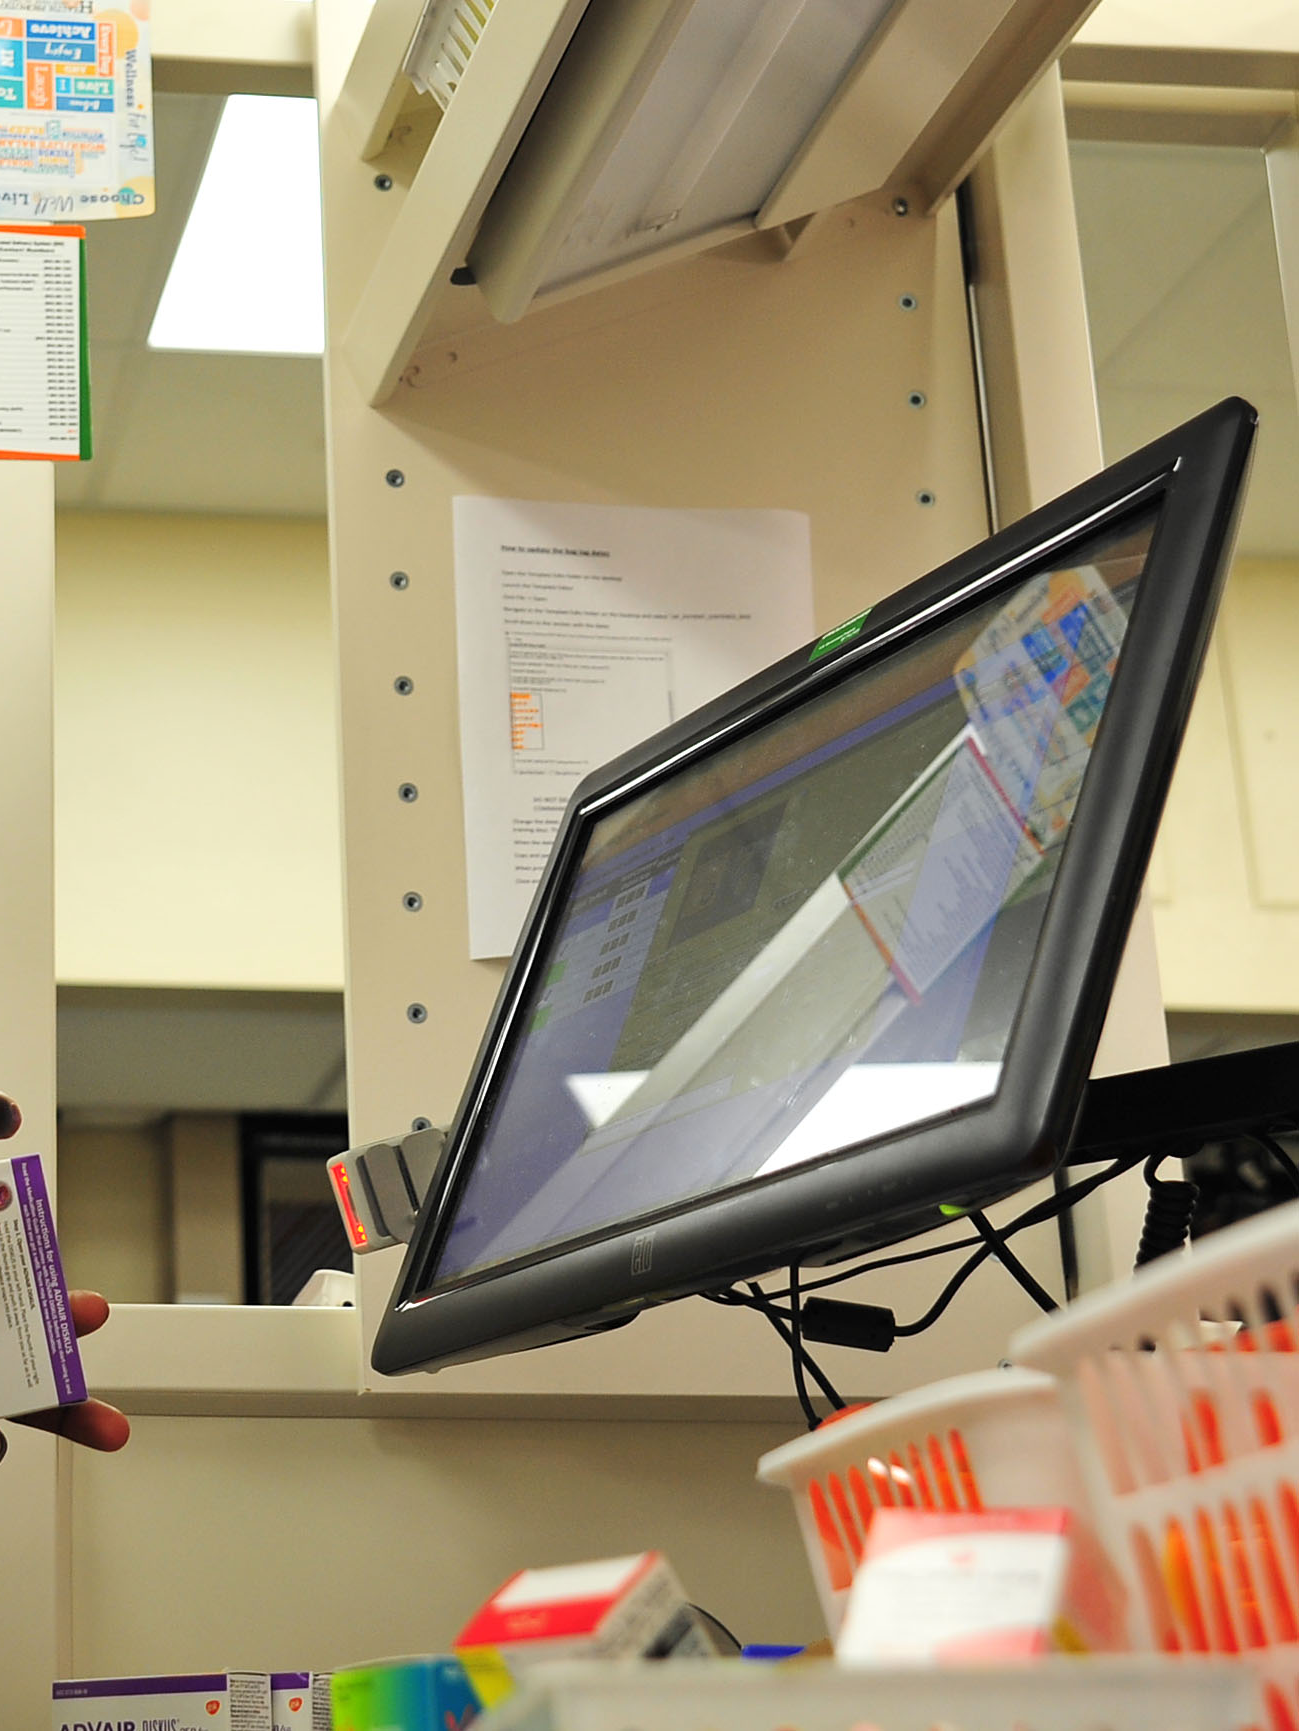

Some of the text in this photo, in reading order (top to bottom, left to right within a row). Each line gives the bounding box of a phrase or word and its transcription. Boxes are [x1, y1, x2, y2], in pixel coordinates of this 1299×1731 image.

[30, 23, 92, 39] Achieve
[43, 41, 82, 60] Enjoy
[76, 80, 111, 94] Live
[125, 48, 137, 108] Wellness
[35, 196, 74, 215] Well
[80, 193, 145, 206] Choose
[35, 1198, 72, 1354] Instructions for using ADVAIR DISKUS
